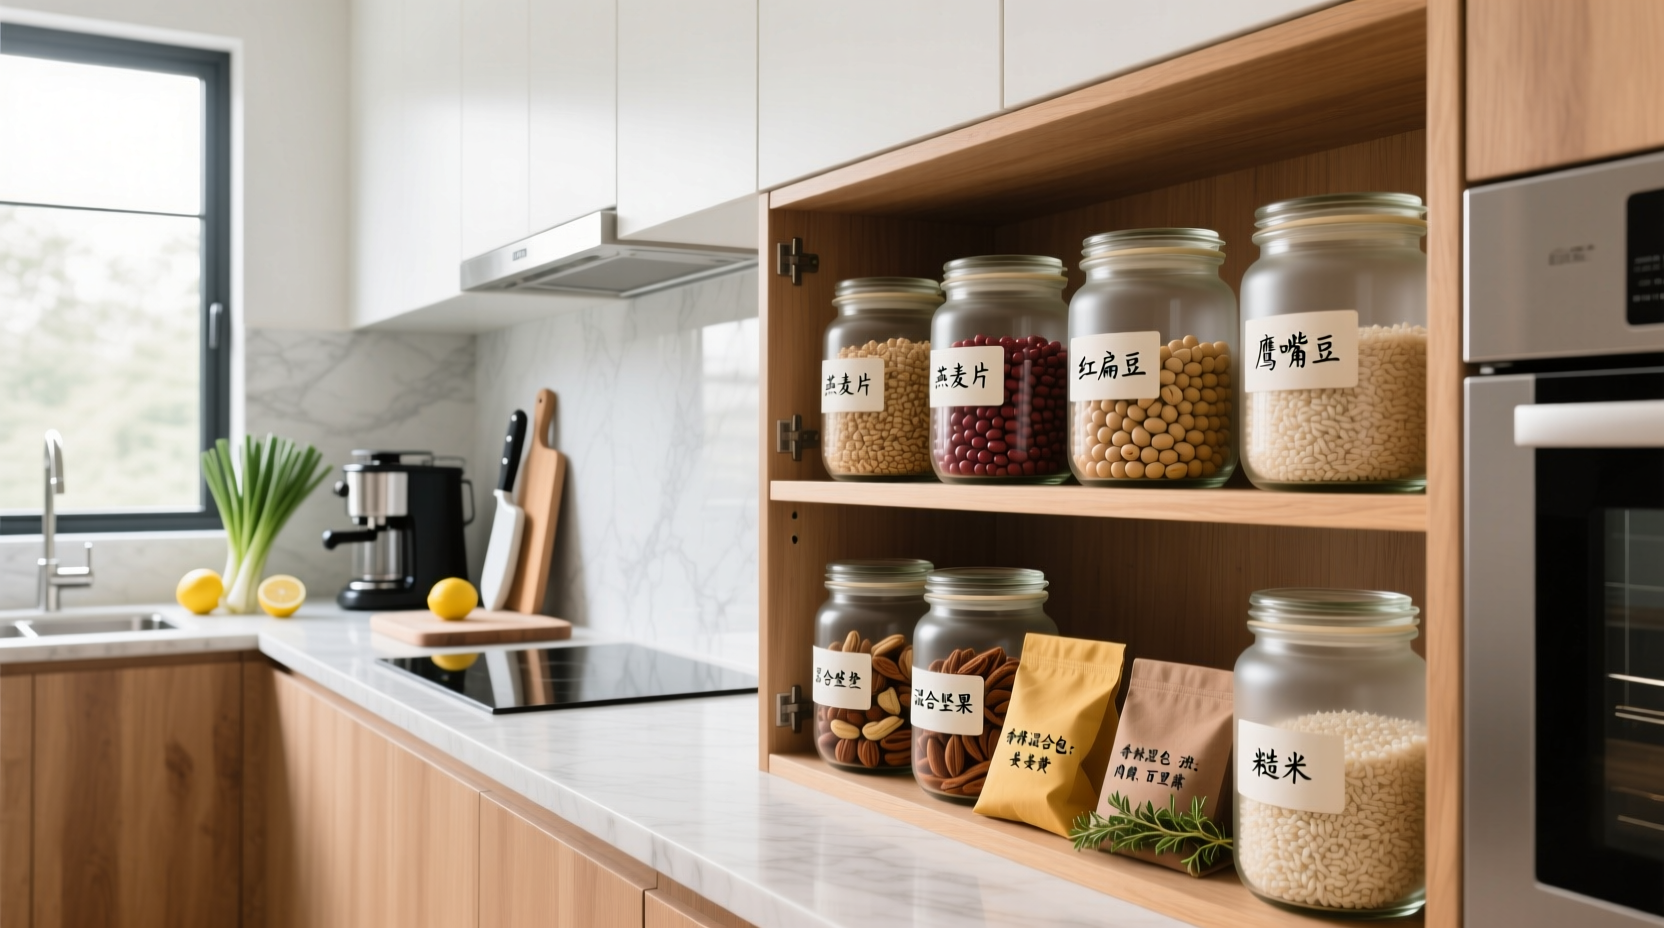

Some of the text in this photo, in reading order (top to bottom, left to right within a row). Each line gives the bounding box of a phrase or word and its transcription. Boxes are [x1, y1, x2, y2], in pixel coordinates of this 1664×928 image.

[1078, 351, 1147, 381] 红扁豆
[1255, 331, 1340, 371] 鹰嘴豆
[935, 362, 989, 389] 燕麦片
[1252, 747, 1312, 785] 糙米
